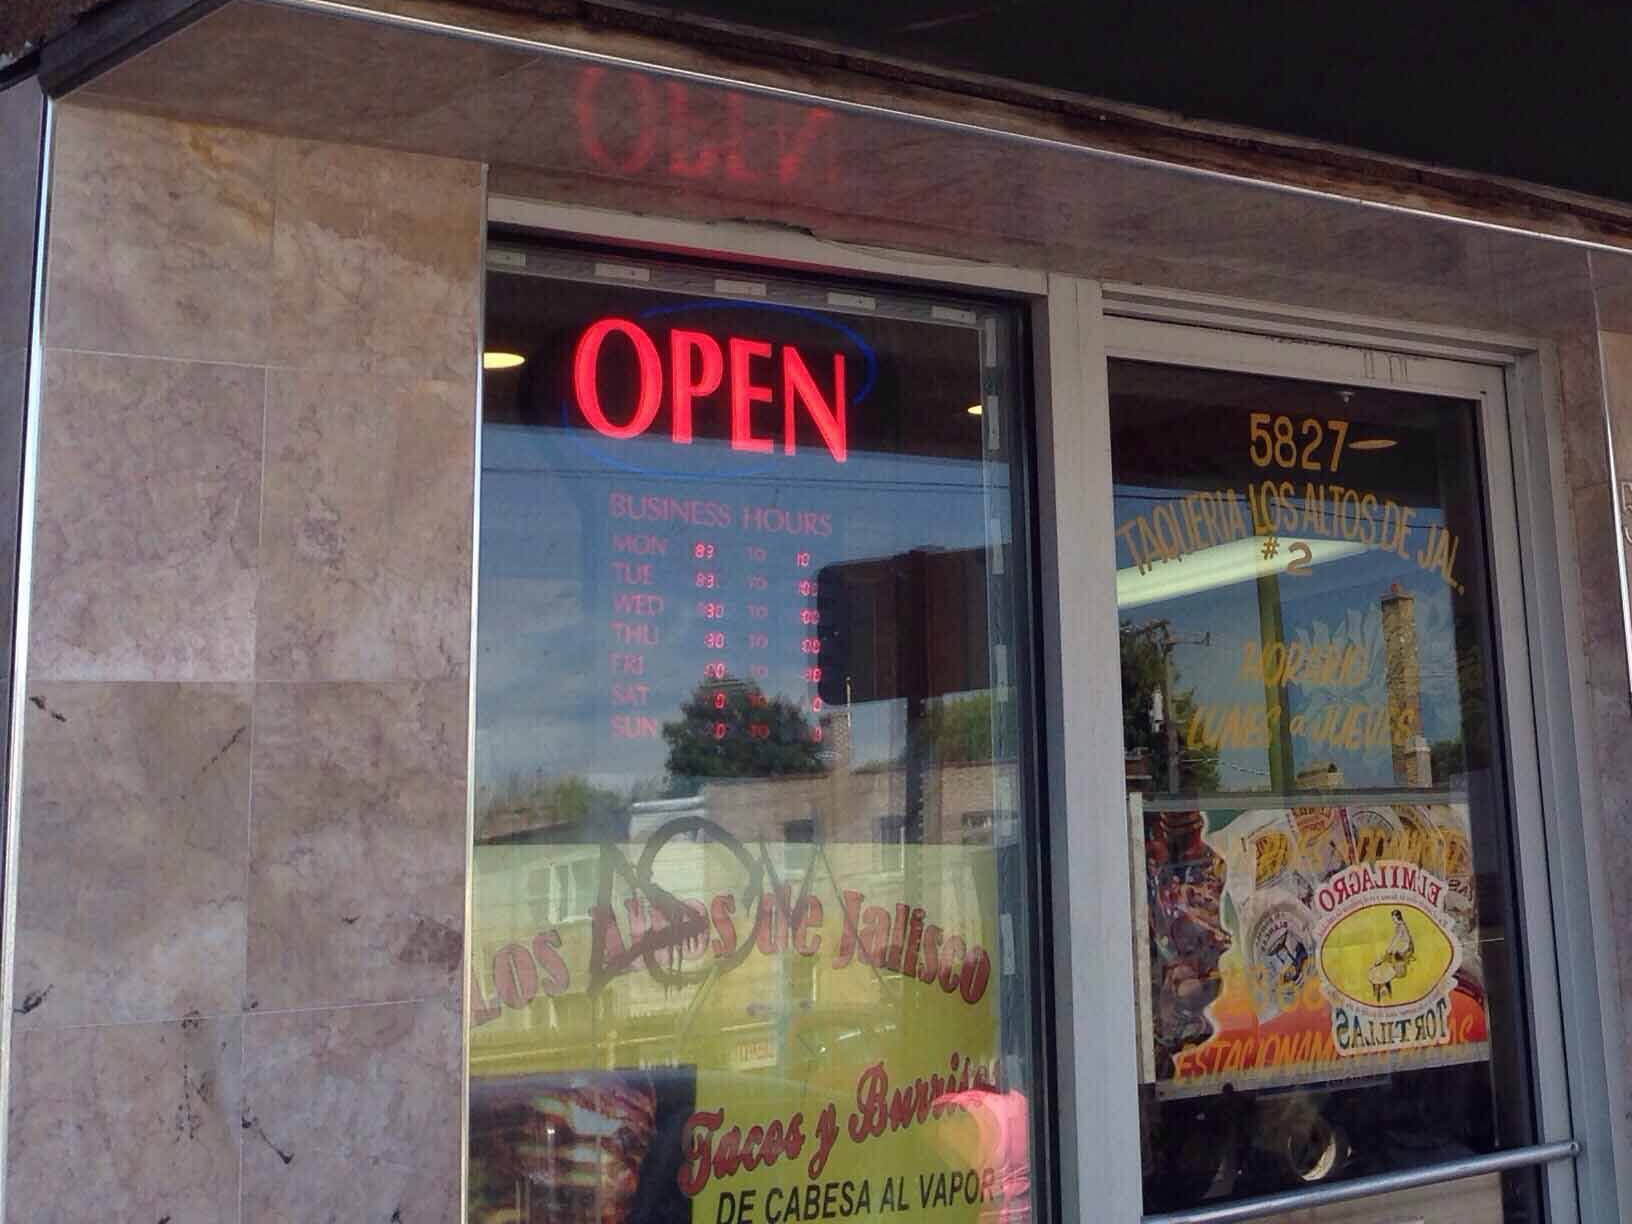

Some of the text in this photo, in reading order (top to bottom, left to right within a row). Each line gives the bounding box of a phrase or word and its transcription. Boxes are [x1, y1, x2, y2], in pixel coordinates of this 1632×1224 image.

[574, 317, 848, 463] OPEN
[1249, 412, 1350, 473] 5827
[609, 490, 833, 537] BUSINESS HOURS
[1116, 487, 1247, 576] TAQUERIA
[1248, 480, 1297, 536] LOS
[1303, 482, 1377, 550] ALTOS
[1380, 499, 1417, 560] DE
[613, 534, 668, 555] MON
[1286, 542, 1314, 576] 2
[613, 561, 656, 585] TUE
[613, 594, 664, 616] WED
[613, 623, 658, 646] THU
[609, 682, 650, 706] SAT
[611, 715, 657, 739] SUN
[757, 887, 824, 957] de
[832, 889, 992, 1005] Jalisco
[678, 1107, 806, 1197] Tacos
[808, 1102, 840, 1179] y
[716, 1168, 996, 1224] DE CABESA AL VAPOR
